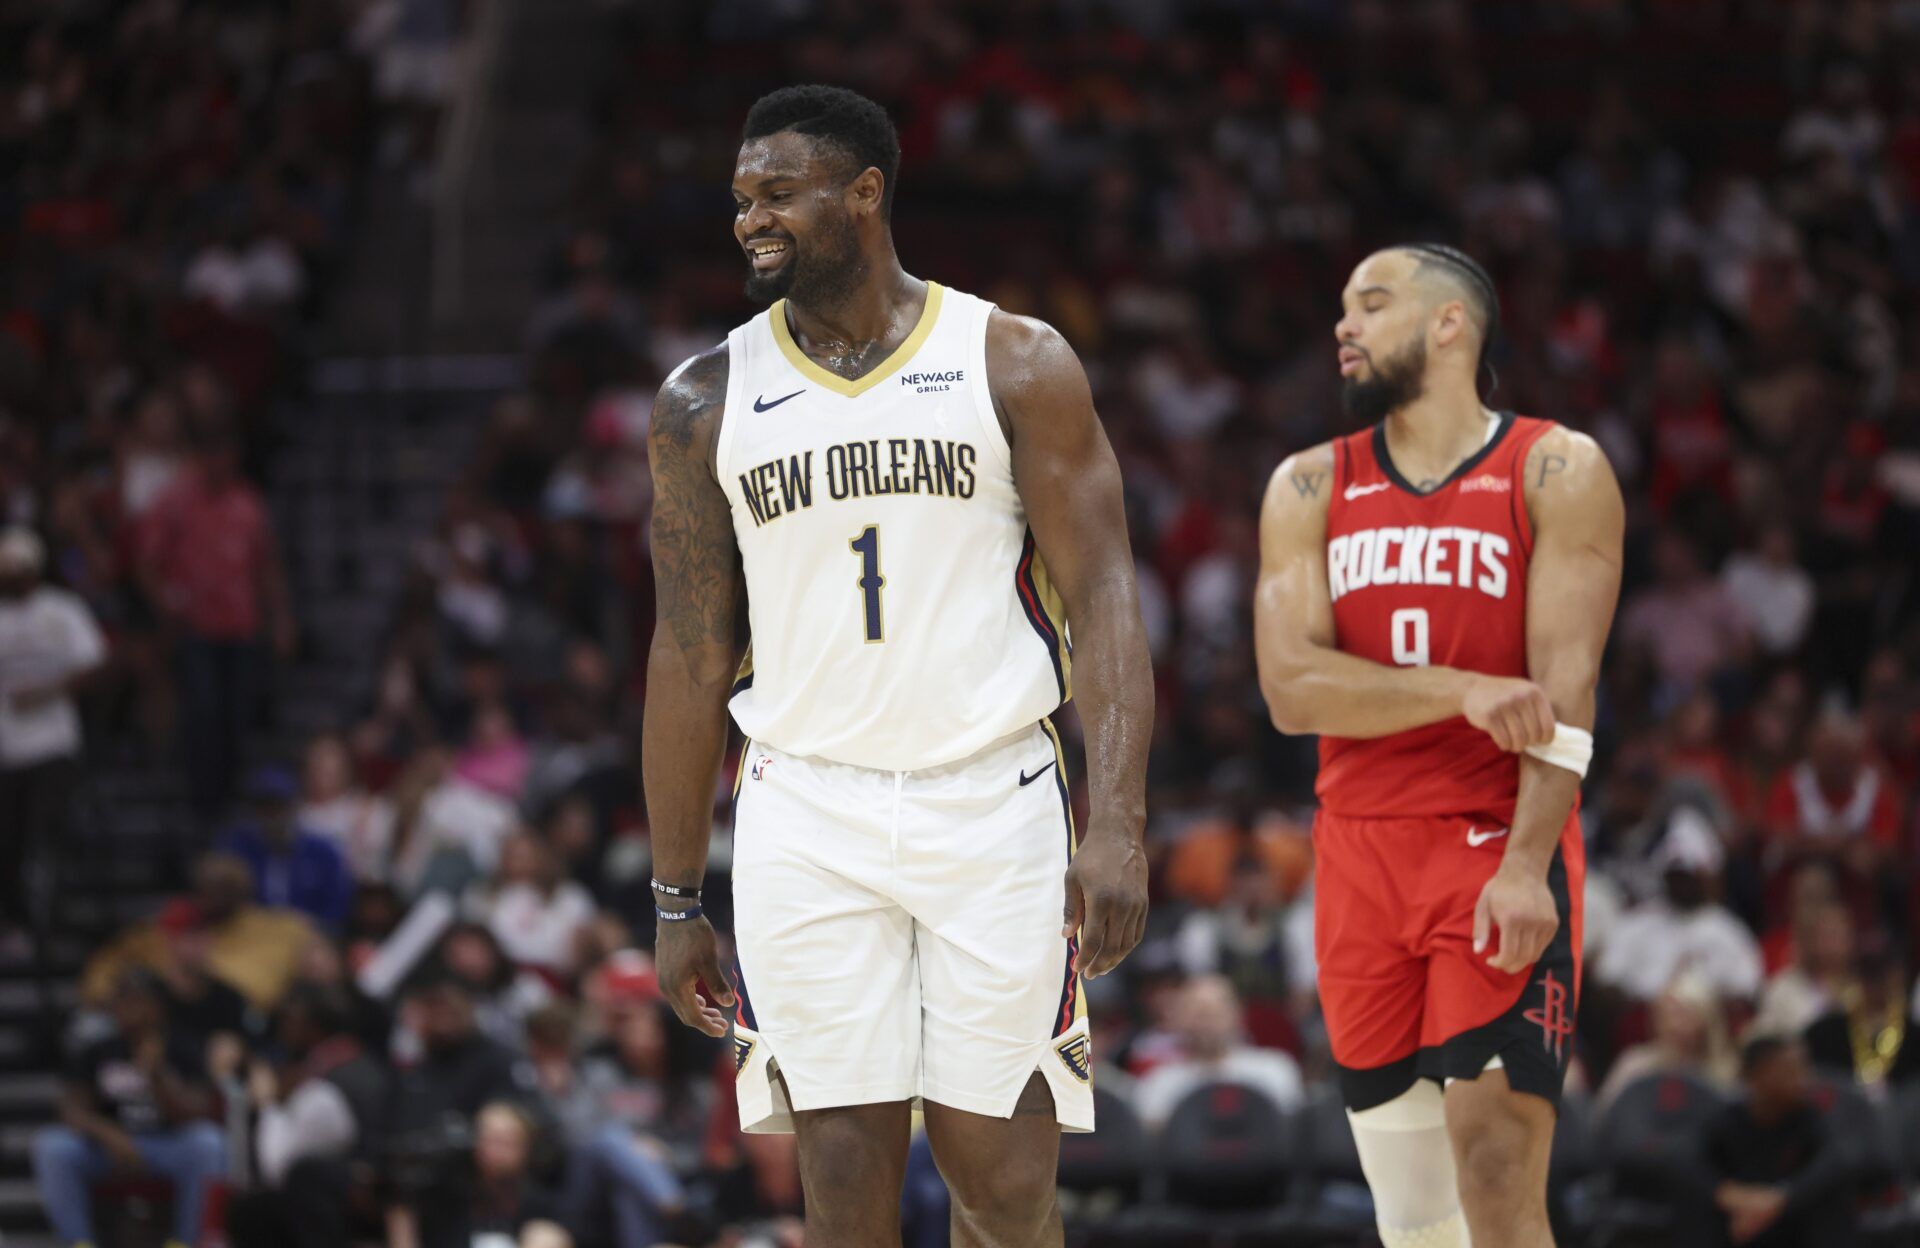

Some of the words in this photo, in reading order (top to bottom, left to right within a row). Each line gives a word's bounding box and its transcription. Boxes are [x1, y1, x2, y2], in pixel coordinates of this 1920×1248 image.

[901, 370, 964, 386] NEWAGE
[916, 384, 950, 394] GRILLS
[738, 449, 814, 528] NEW
[826, 439, 977, 501] ORLEANS
[1291, 472, 1326, 499] W
[1327, 525, 1509, 602] ROCKETS
[848, 523, 887, 645] 1
[666, 886, 680, 895] DIE
